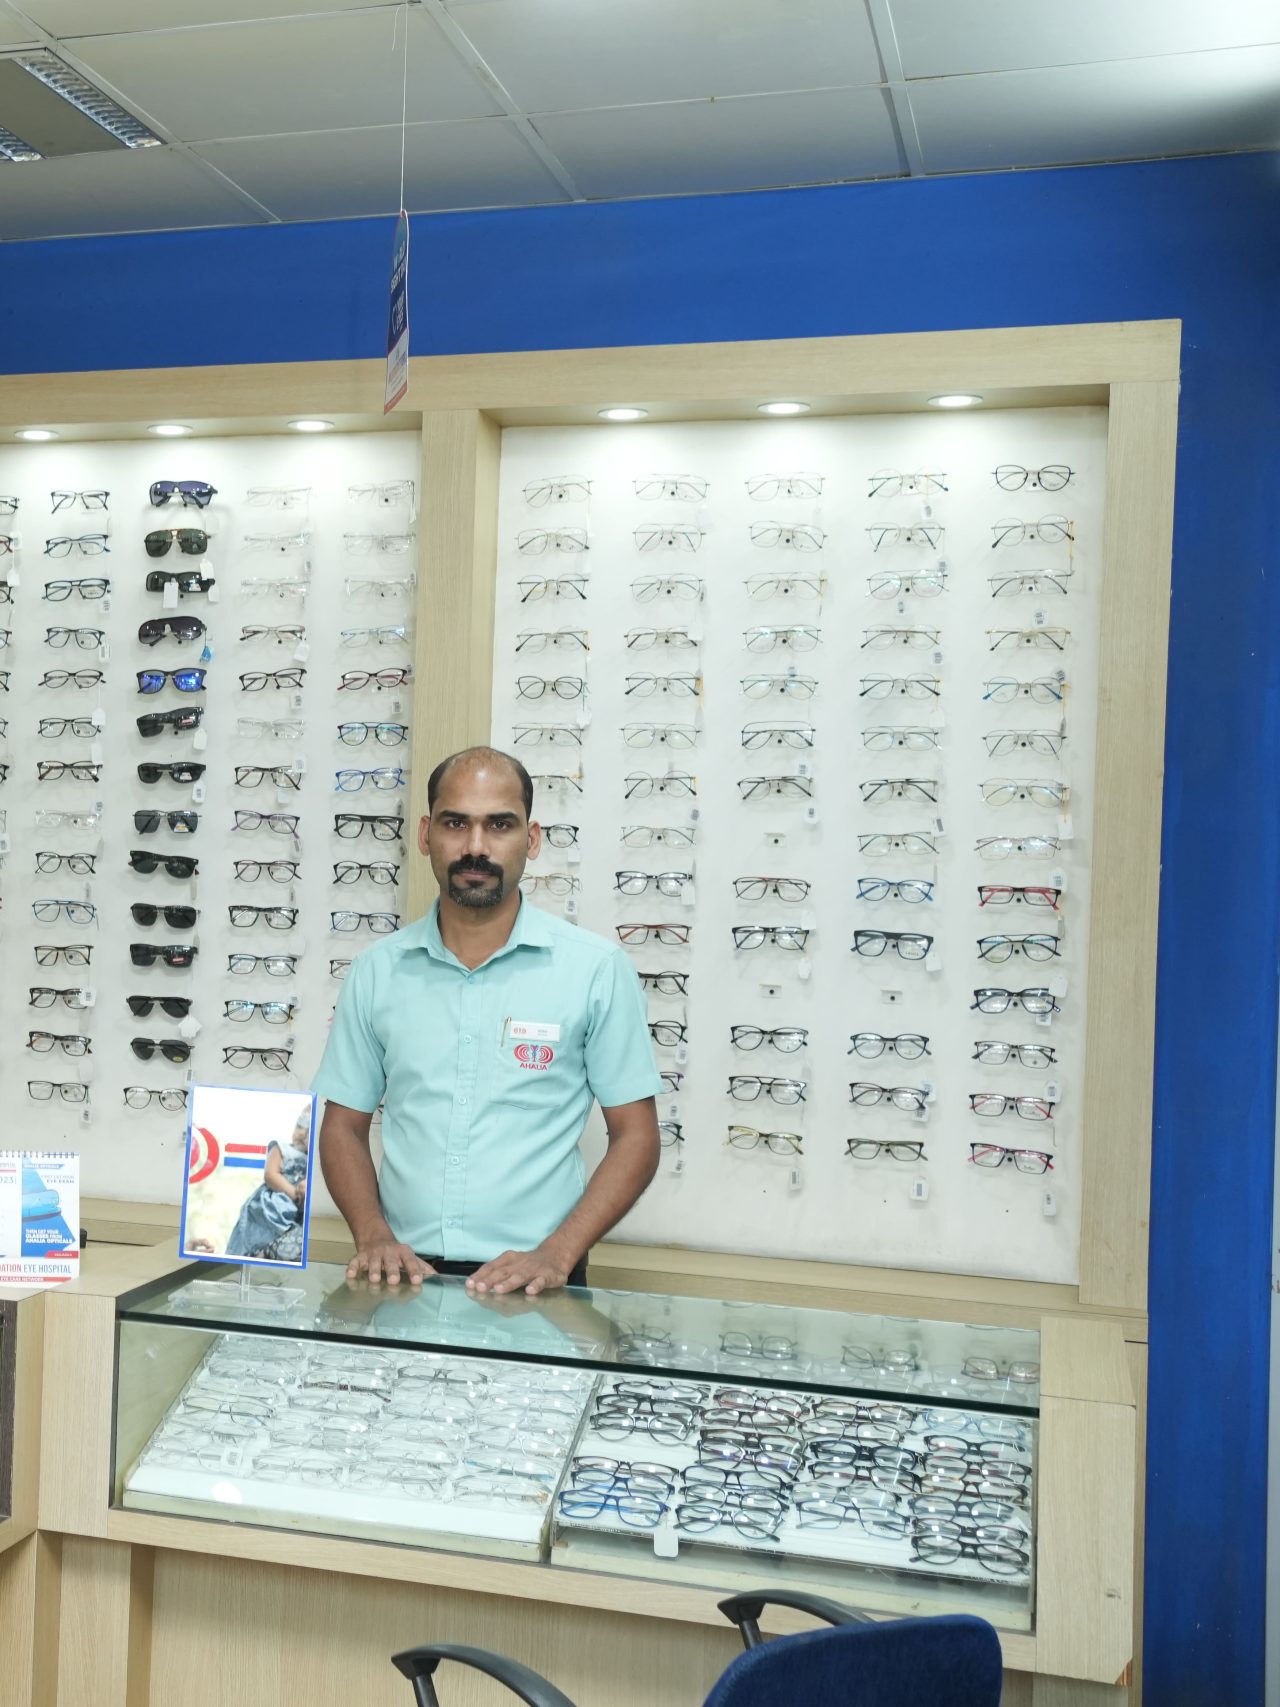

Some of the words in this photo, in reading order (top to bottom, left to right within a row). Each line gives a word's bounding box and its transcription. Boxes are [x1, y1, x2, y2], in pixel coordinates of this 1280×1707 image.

[520, 1063, 548, 1071] AHALIA
[23, 1264, 36, 1273] EYE
[38, 1264, 72, 1274] HOSPITAL
